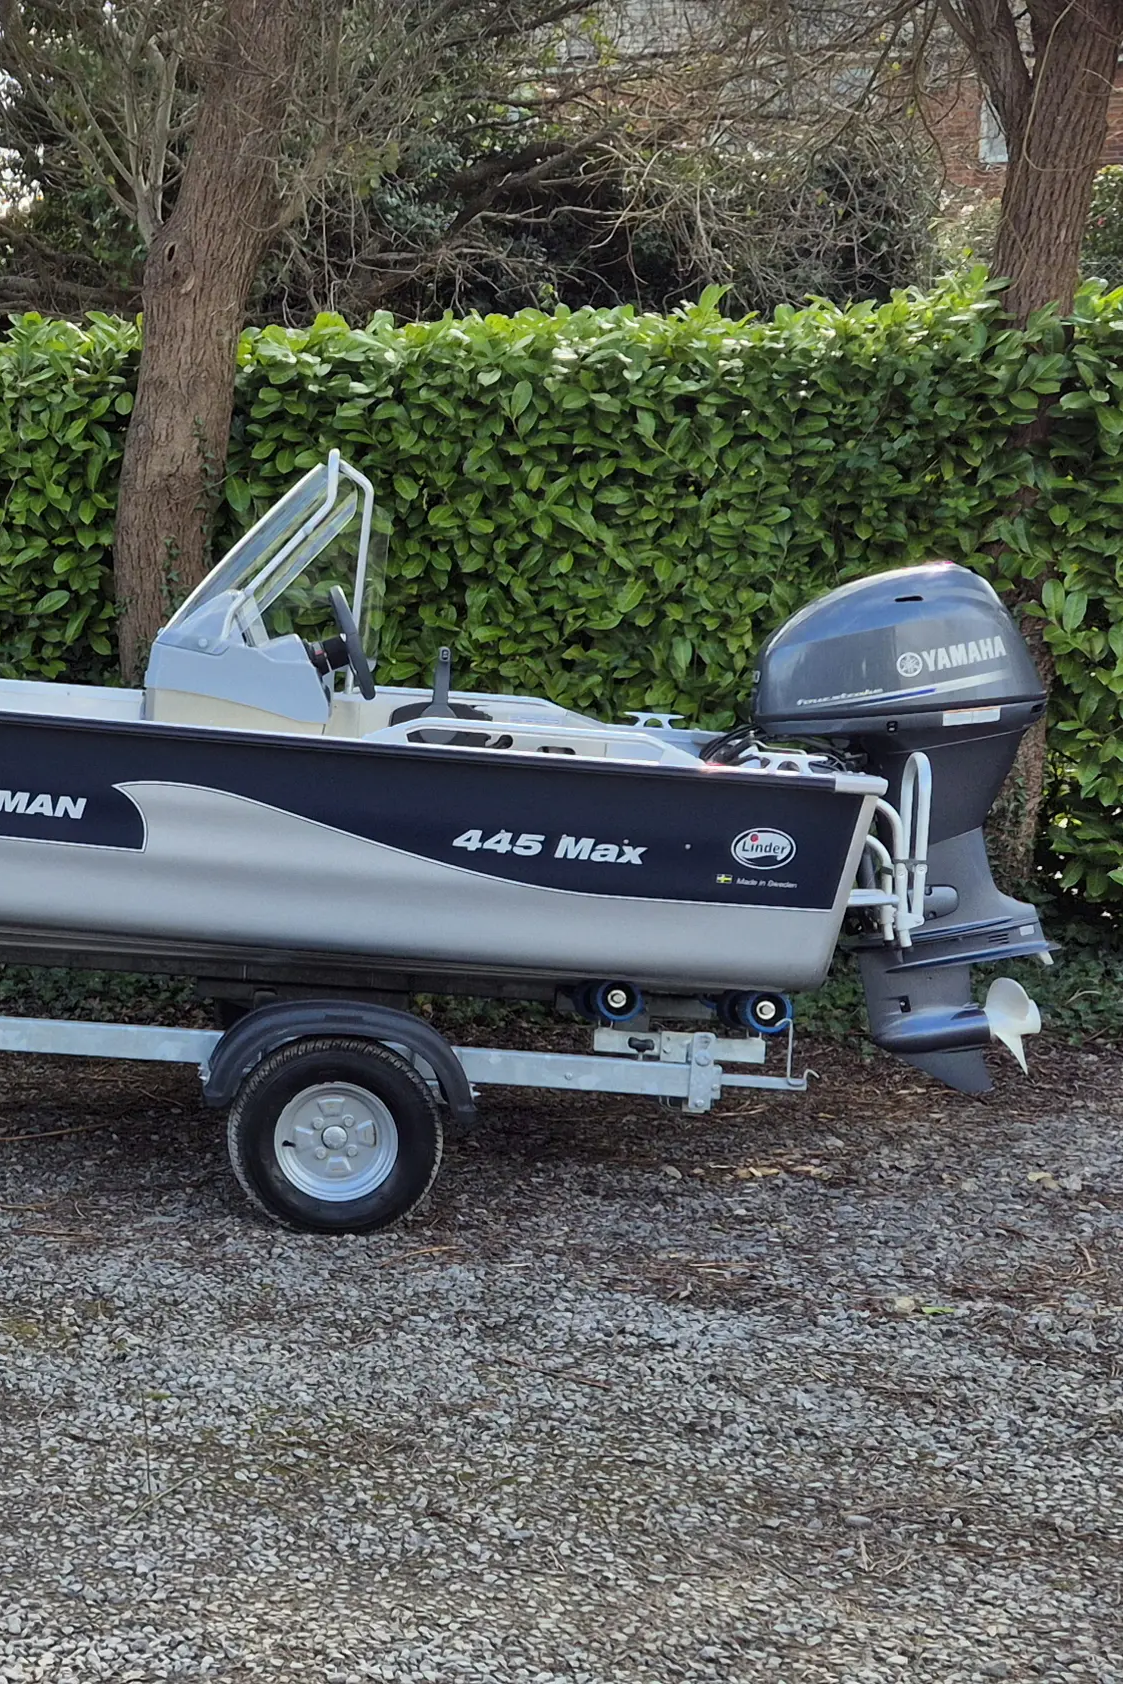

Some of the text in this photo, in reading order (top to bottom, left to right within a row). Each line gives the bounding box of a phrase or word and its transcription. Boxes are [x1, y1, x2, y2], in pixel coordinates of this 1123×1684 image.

[921, 635, 1007, 672] YAMAHA
[452, 829, 647, 865] 445 Max
[741, 833, 787, 854] Linder
[736, 878, 758, 886] Made
[767, 879, 798, 888] Sweden
